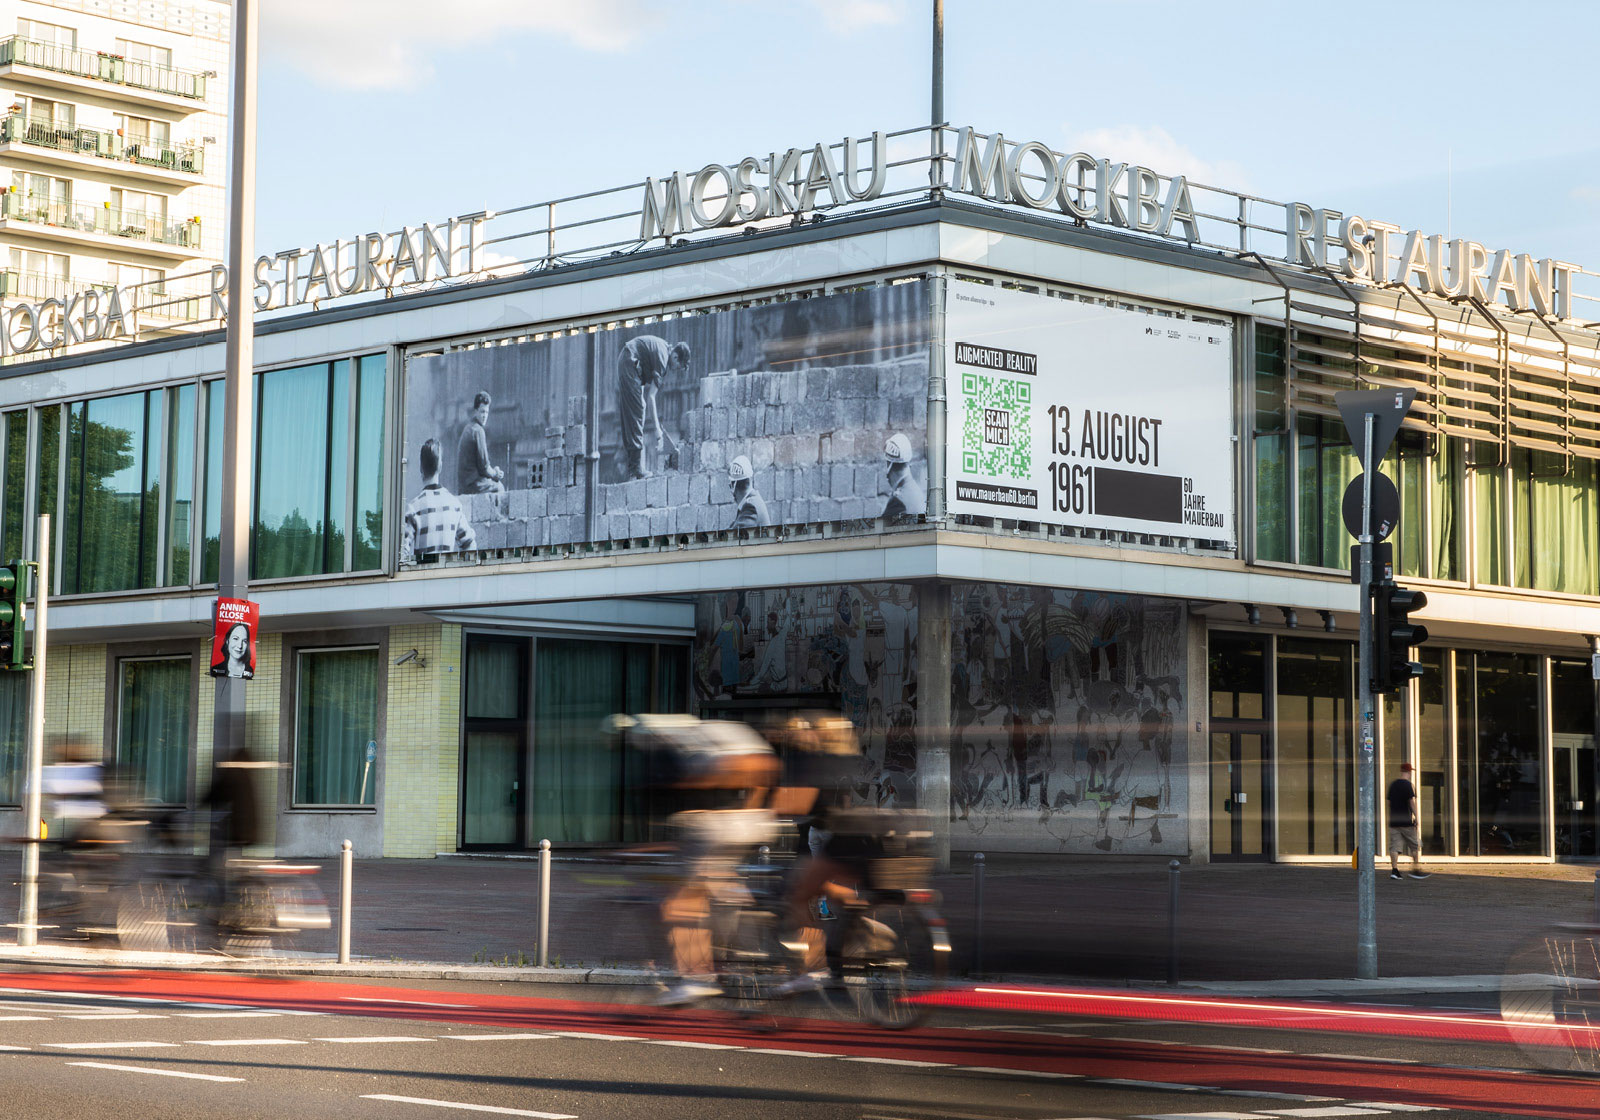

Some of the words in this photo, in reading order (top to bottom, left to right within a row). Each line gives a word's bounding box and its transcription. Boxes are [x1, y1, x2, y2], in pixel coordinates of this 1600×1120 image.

[639, 131, 886, 242] MOSKAU
[211, 210, 492, 319] RSTAURANT
[1286, 202, 1583, 320] RESTAURANT
[0, 285, 127, 357] ОСКВА
[957, 345, 1004, 368] AUGMENTED
[1006, 353, 1036, 373] REALITY
[986, 410, 1008, 428] SCAN
[986, 426, 1008, 445] MICH
[1047, 404, 1076, 457] 13.
[1080, 409, 1162, 467] AUGUST
[1047, 461, 1093, 515] 1961
[1184, 477, 1193, 493] 60
[958, 487, 1036, 506] www.mauerbau60.berlin
[1184, 493, 1206, 511] JAHRE
[1184, 510, 1224, 528] MAUERBAU
[219, 602, 250, 614] ANNIKA
[219, 611, 244, 620] KLOSE
